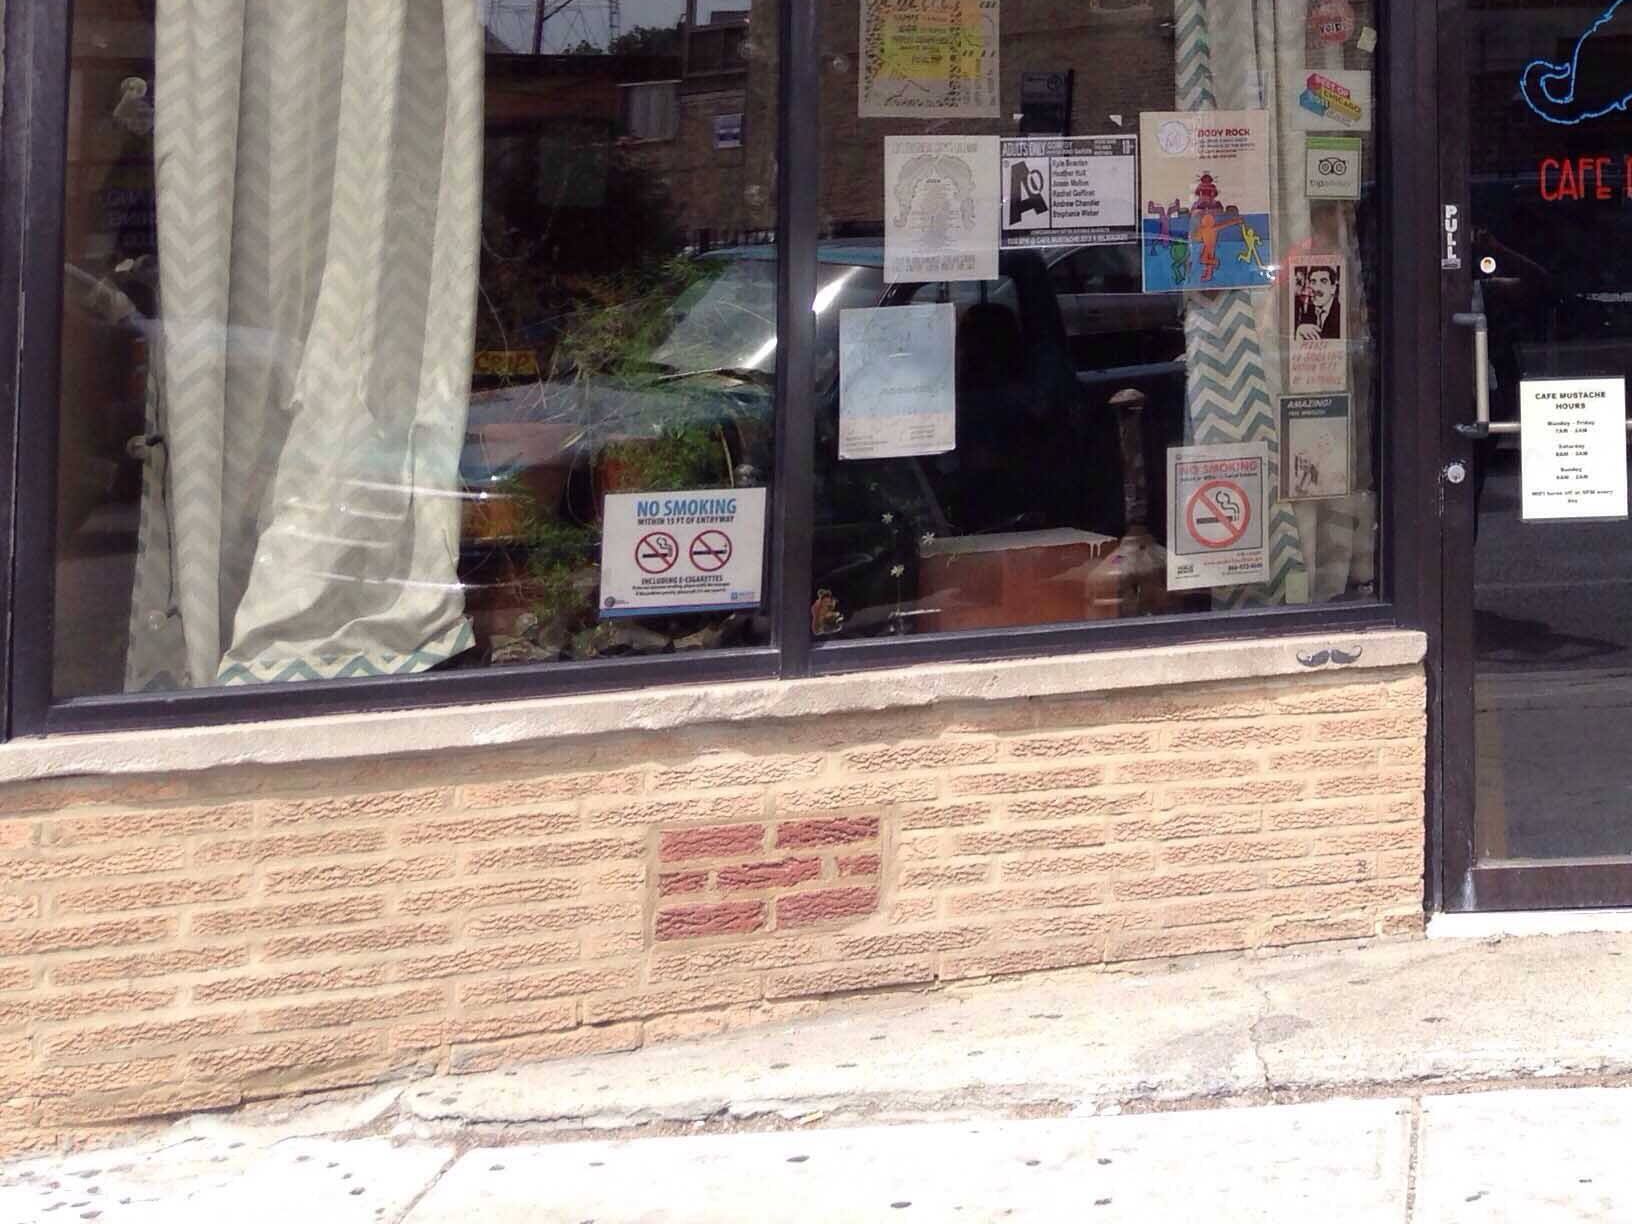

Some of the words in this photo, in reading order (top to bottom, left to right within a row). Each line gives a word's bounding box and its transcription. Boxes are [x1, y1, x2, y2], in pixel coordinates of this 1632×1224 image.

[1226, 128, 1250, 136] ROCK
[1538, 157, 1612, 201] CAFE
[1445, 205, 1458, 261] PULL
[1559, 391, 1606, 399] MUSTACHE
[1287, 399, 1332, 408] AMAZING!
[1204, 460, 1257, 474] SMOKING
[637, 500, 660, 517] NO
[664, 498, 736, 516] SMOKING
